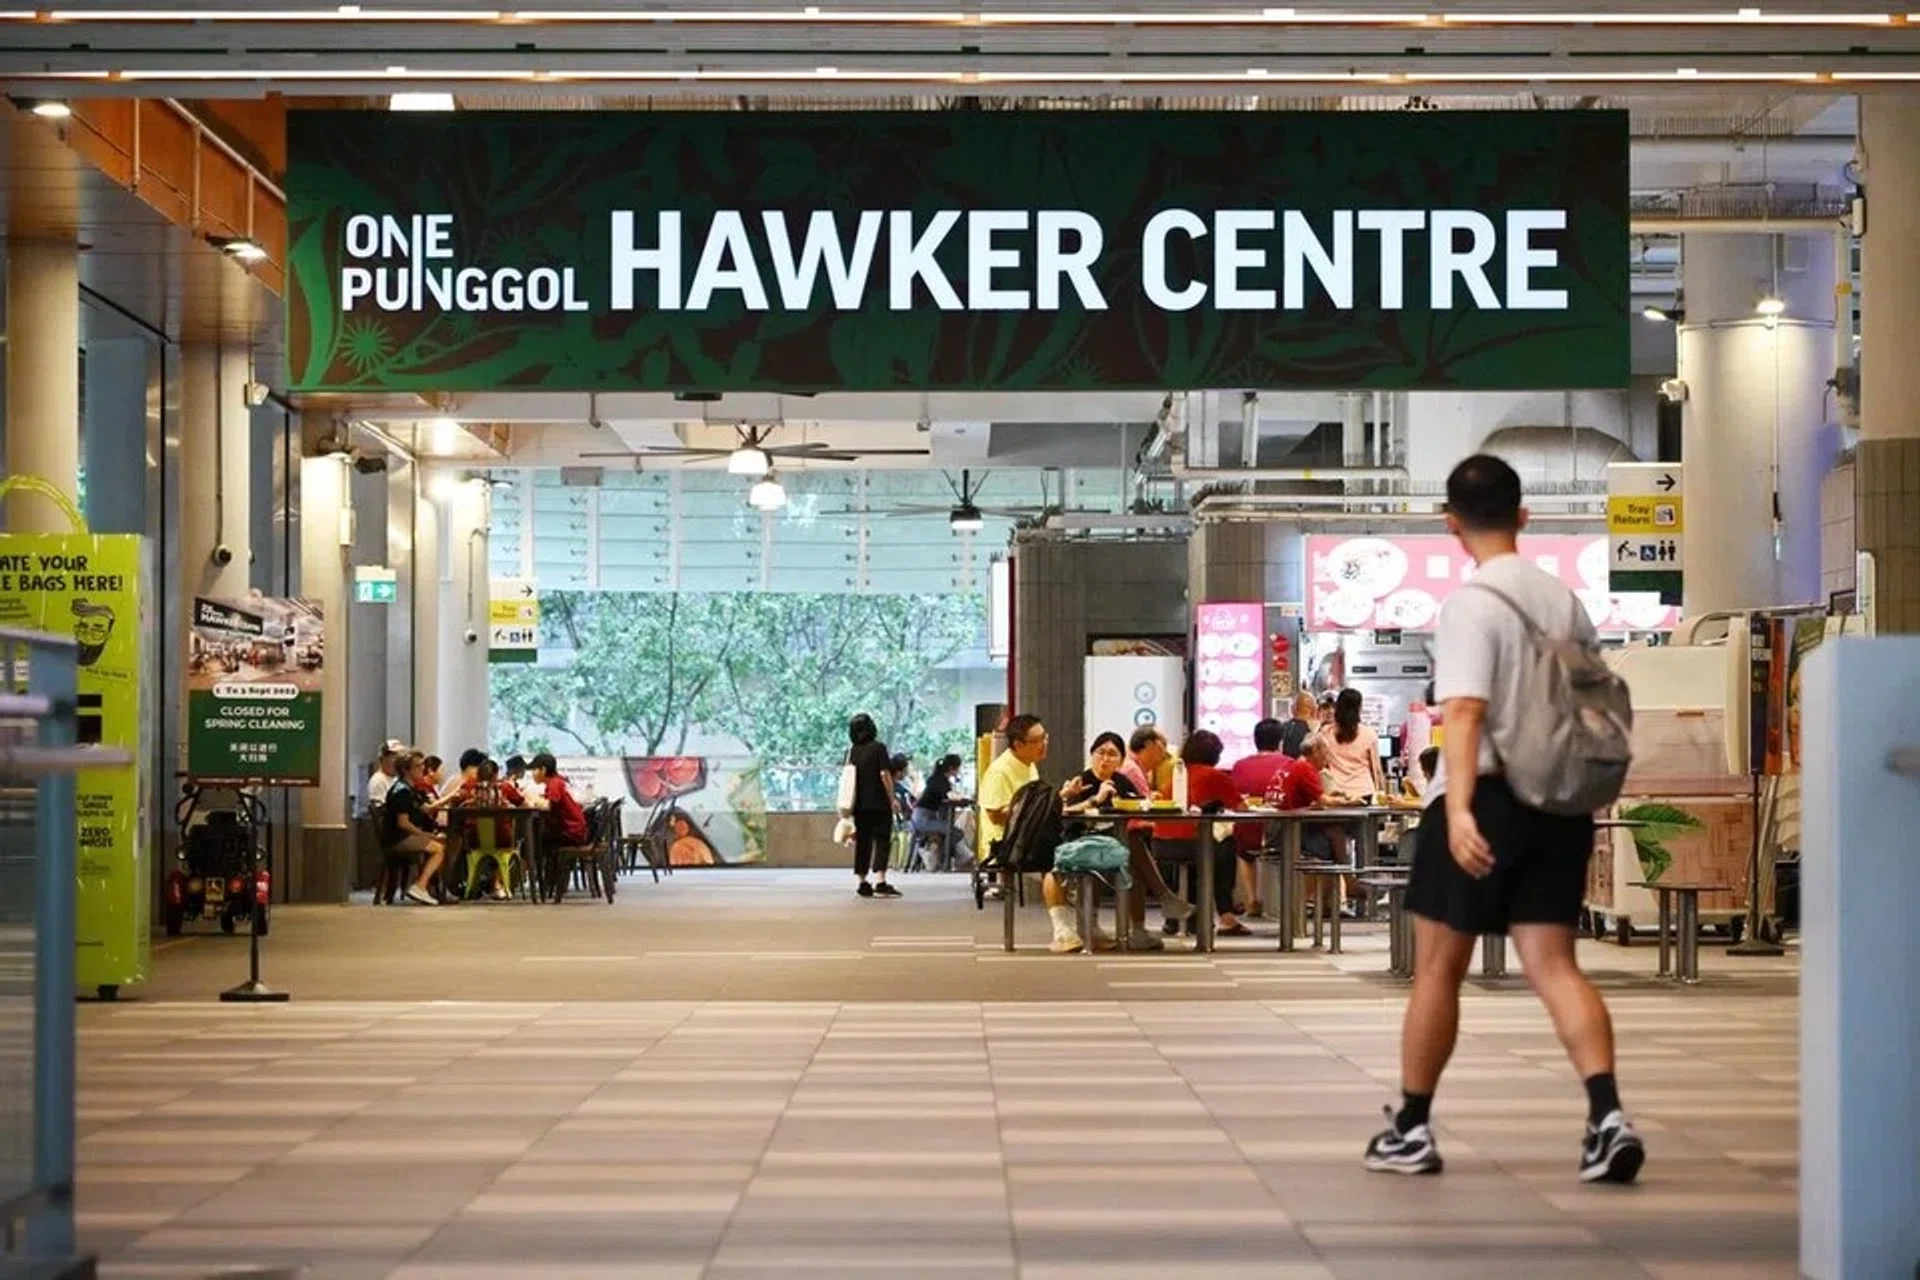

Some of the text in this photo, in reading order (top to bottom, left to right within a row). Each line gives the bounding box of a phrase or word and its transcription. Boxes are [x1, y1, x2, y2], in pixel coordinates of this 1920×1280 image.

[346, 214, 454, 258] ONE
[611, 208, 1568, 311] HAWKER CENTRE
[342, 267, 589, 311] PUNGGOL
[1627, 503, 1650, 515] Tray
[1614, 514, 1650, 525] Return
[0, 556, 30, 571] ATE
[20, 575, 66, 591] BAGS
[74, 575, 123, 591] HERE!
[220, 706, 290, 716] CLOSED FOR
[204, 718, 305, 730] SPRING CLEANING
[81, 826, 110, 837] ZERO
